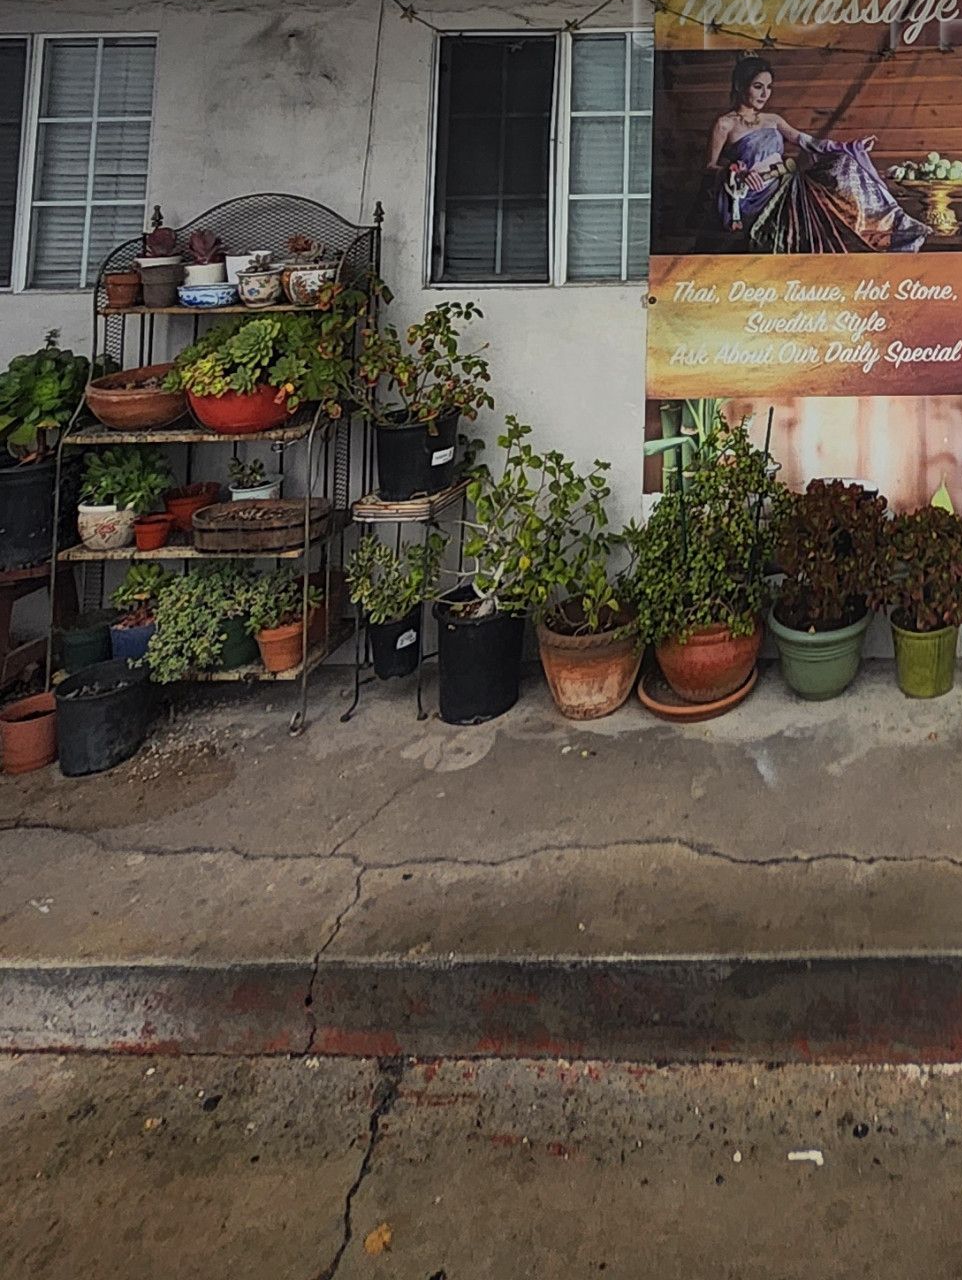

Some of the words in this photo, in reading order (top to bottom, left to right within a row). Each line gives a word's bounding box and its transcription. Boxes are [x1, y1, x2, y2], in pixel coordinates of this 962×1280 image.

[673, 281, 721, 304] Thai,
[728, 280, 777, 307] Deep
[784, 279, 846, 303] Tissue,
[853, 279, 890, 301] Hot
[894, 278, 958, 301] Stone,
[744, 310, 828, 333] Swedish
[833, 310, 887, 342] Style
[669, 343, 708, 366] Ask
[716, 343, 773, 365] About
[778, 343, 821, 364] Our
[825, 341, 880, 373] Daily
[884, 340, 962, 370] Special
